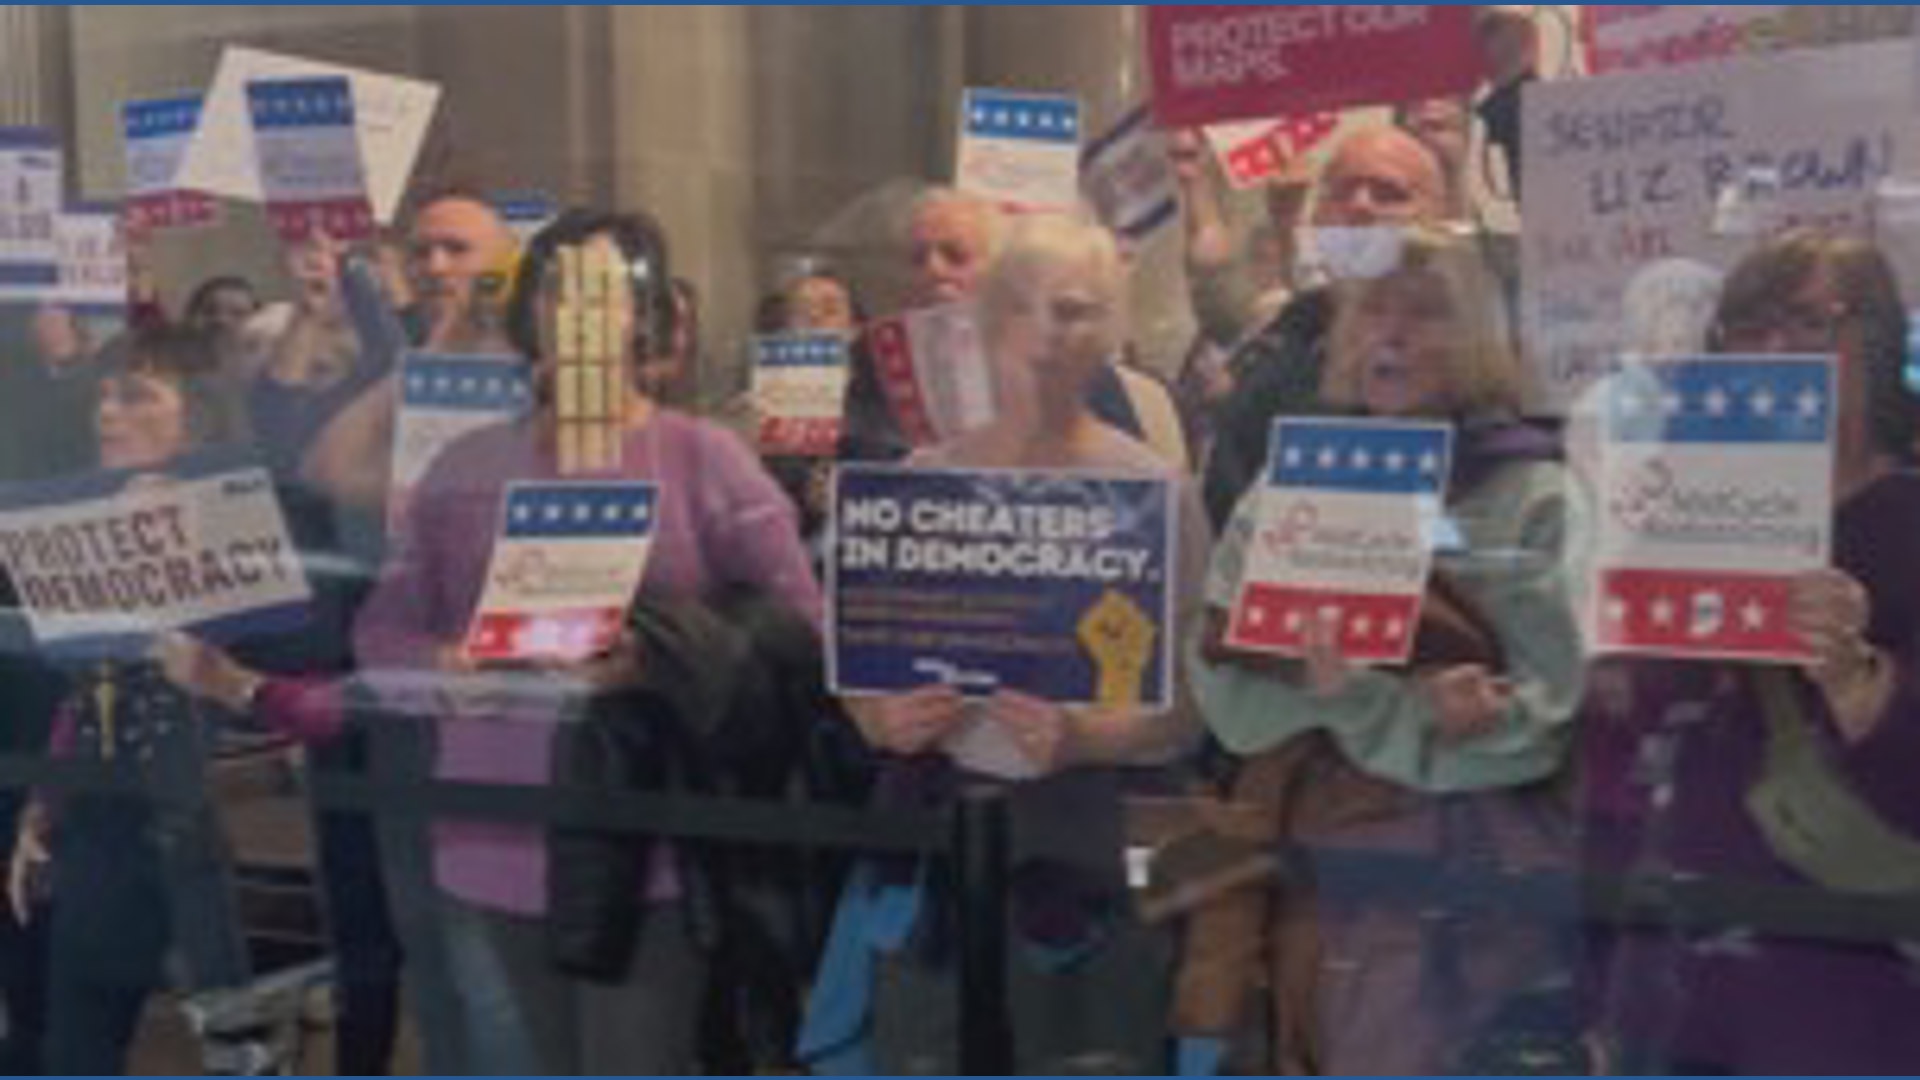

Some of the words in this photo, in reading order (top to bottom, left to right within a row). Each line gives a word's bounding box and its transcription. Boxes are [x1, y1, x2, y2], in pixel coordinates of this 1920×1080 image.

[1171, 5, 1337, 53] PROTECT
[0, 504, 187, 570] PROTECT
[841, 498, 902, 533] NO
[911, 500, 1117, 541] CHEATERS
[24, 536, 288, 613] DEMOCRACY
[840, 537, 888, 569] IN
[898, 539, 1161, 581] DEMOCRACY.
